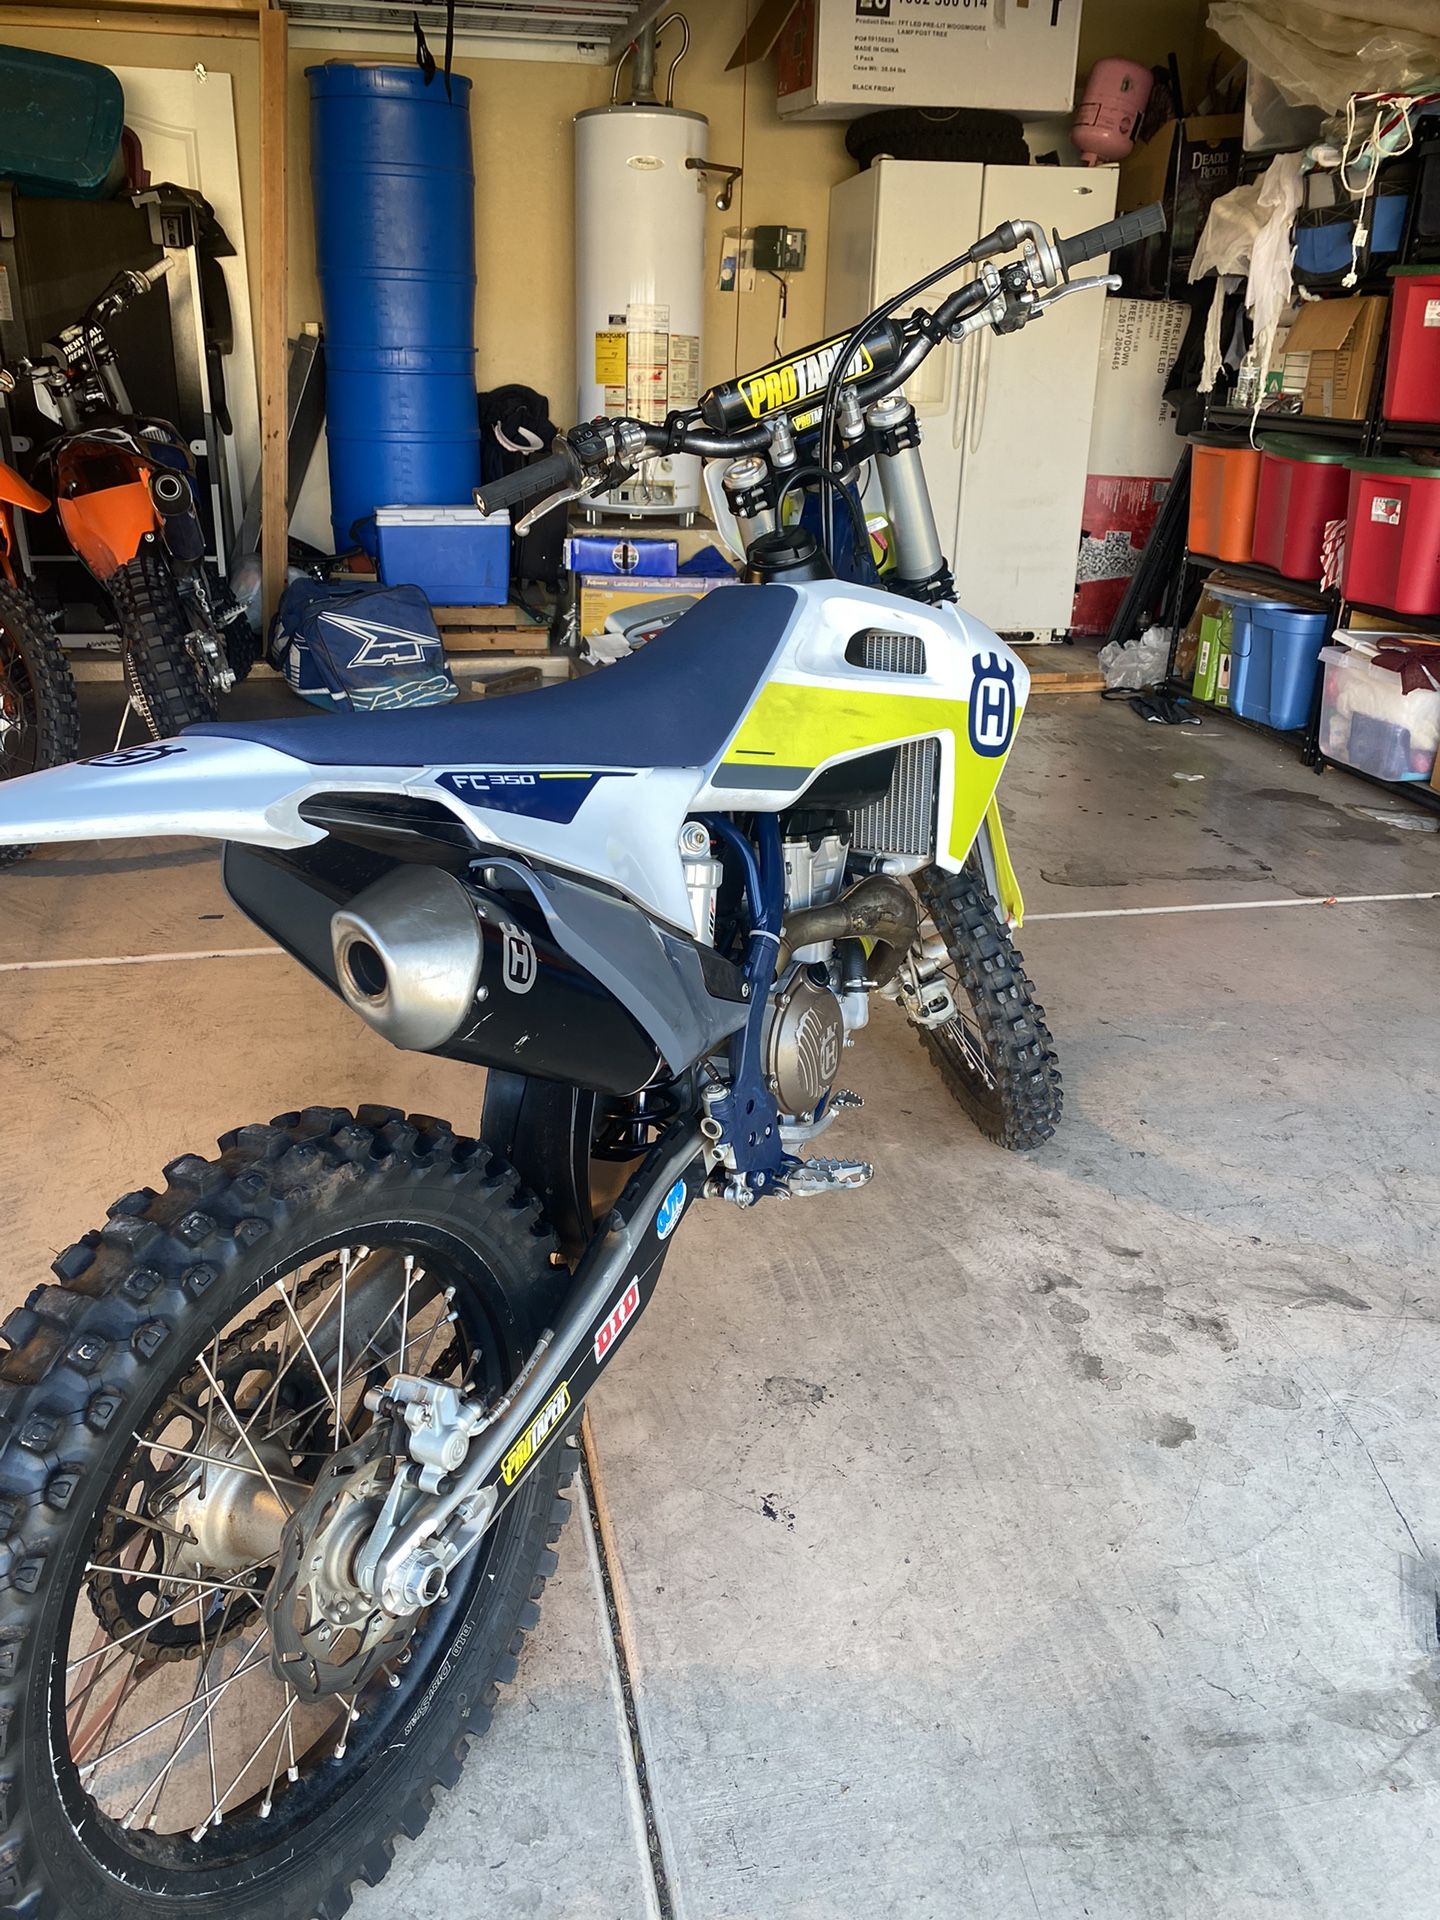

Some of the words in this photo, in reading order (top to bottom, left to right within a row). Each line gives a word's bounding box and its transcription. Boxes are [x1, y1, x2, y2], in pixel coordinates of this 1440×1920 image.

[1129, 300, 1138, 324] TREE
[62, 326, 102, 356] RENTAL
[1121, 324, 1134, 366] LAYDOWN
[1160, 328, 1171, 357] WHITE
[1157, 357, 1166, 374] LED
[1158, 402, 1168, 421] PINE
[614, 554, 637, 562] PESI
